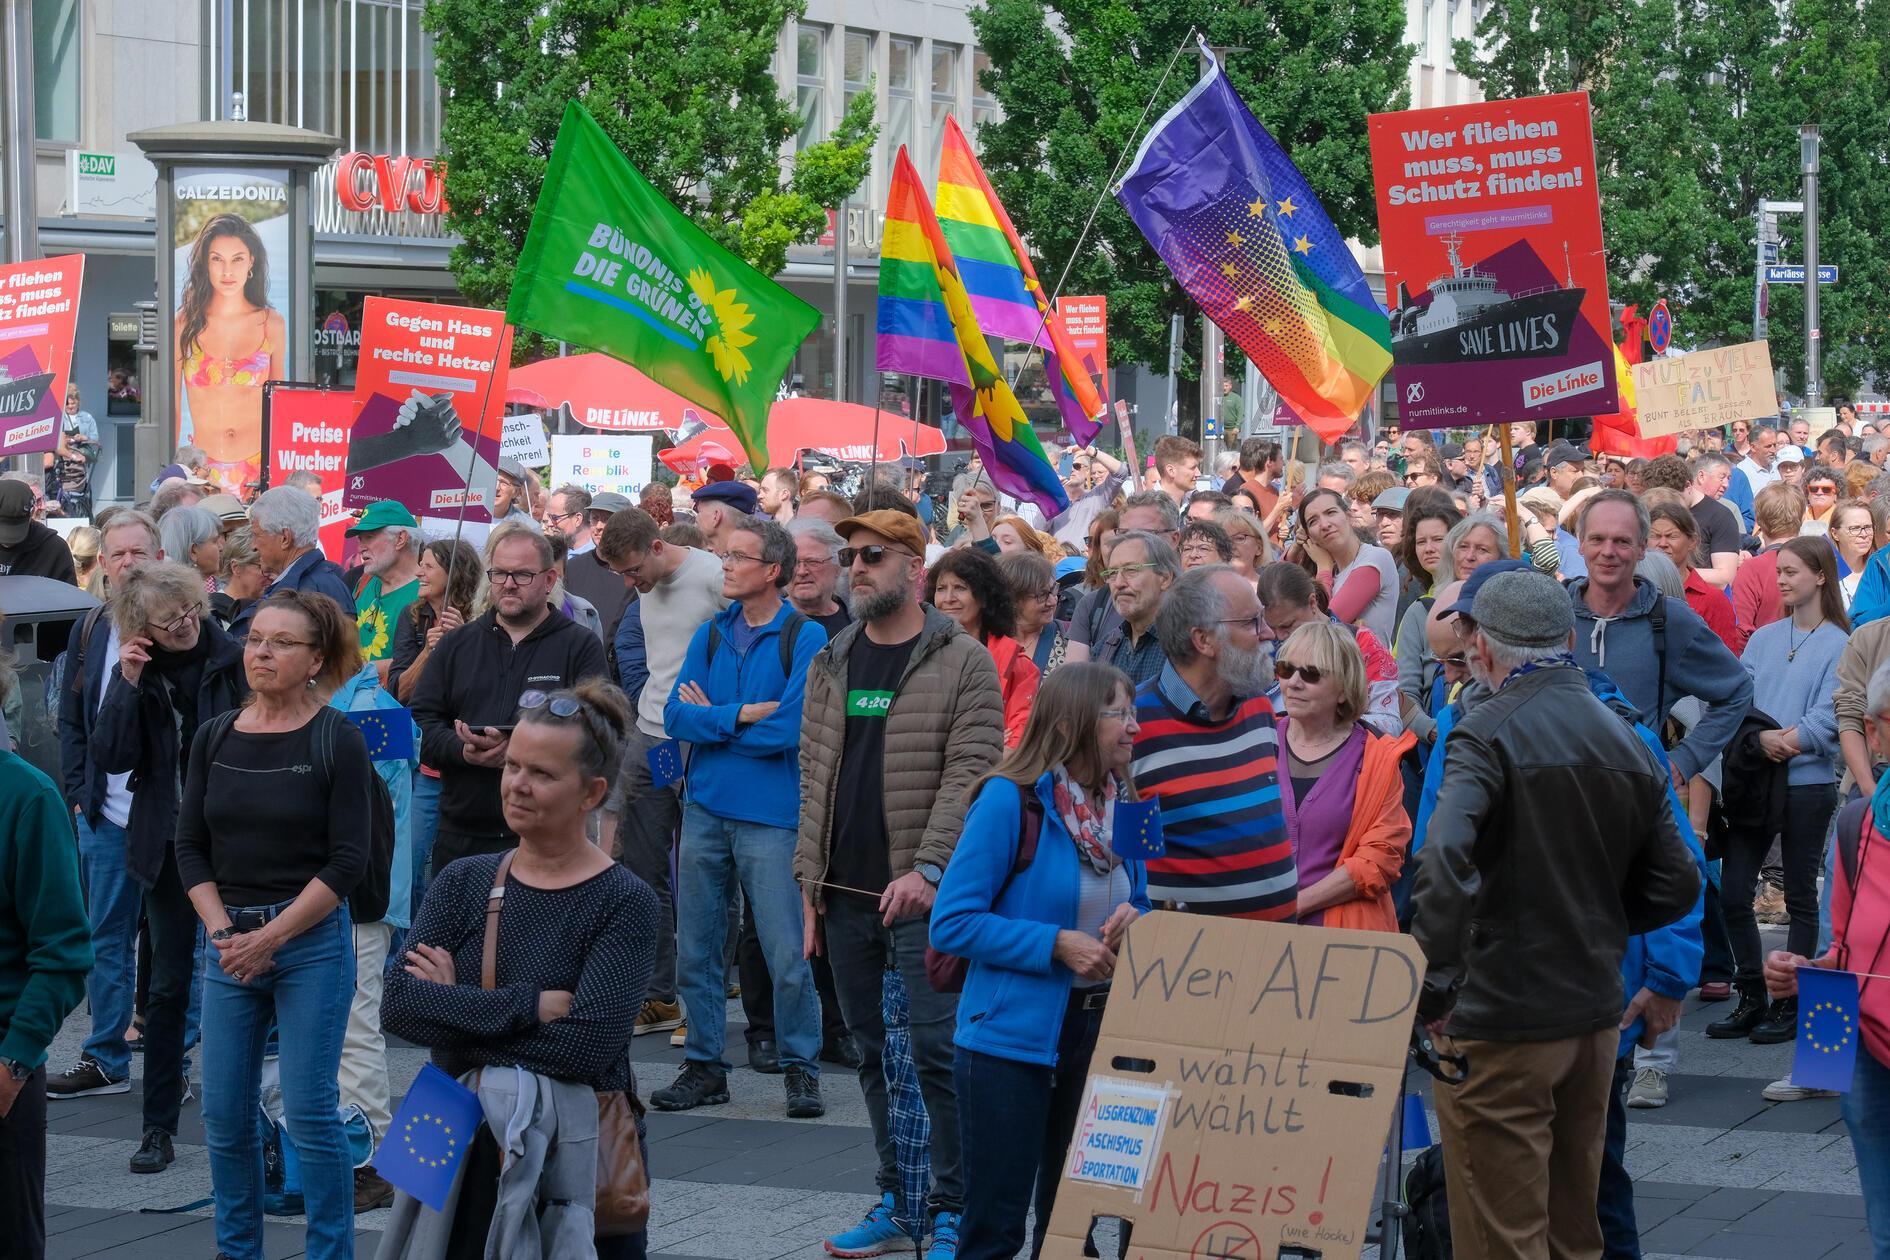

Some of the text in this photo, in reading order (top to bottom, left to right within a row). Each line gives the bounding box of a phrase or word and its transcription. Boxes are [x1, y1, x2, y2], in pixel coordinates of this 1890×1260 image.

[1401, 119, 1558, 151] Wer fliehen
[90, 156, 114, 173] DAV
[1404, 147, 1562, 178] muss, muss
[176, 185, 287, 201] CALZEDONIA
[337, 152, 449, 215] CVJ
[1388, 166, 1584, 205] Schutz finden!
[1429, 211, 1548, 229] Gerechtigkeit geht #nurmitlinks
[587, 222, 684, 293] BÜNDNIS
[9, 271, 63, 288] fliehen
[0, 286, 62, 306] ss, muss
[573, 251, 705, 342] DIE GRÜNEN
[15, 299, 71, 319] finden!
[111, 322, 138, 332] Toilette
[386, 311, 493, 337] Gegen Hass
[314, 329, 361, 346] OSTBAR
[420, 336, 455, 350] und
[1459, 313, 1560, 356] SAVE LIVES
[373, 347, 495, 372] rechte Hetze!
[1639, 358, 1684, 388] MUT
[1530, 382, 1555, 400] Die
[587, 407, 610, 423] DIE
[1408, 404, 1468, 417] nurmitlinks.de
[1644, 411, 1669, 423] BUNT
[9, 430, 24, 442] Die
[292, 421, 343, 444] Preise
[502, 421, 530, 433] nsch-
[500, 435, 532, 449] ichkeit
[278, 449, 342, 471] Wucher
[505, 449, 543, 462] ahren!
[435, 494, 452, 504] Die
[321, 500, 339, 519] Die
[856, 696, 891, 709] 4:20
[1126, 928, 1419, 1024] Wer AFD
[1085, 1094, 1157, 1127] AUSGRENZUNG
[1081, 1123, 1143, 1156] FASCHISMUS
[1072, 1150, 1139, 1184] DEPORTATION
